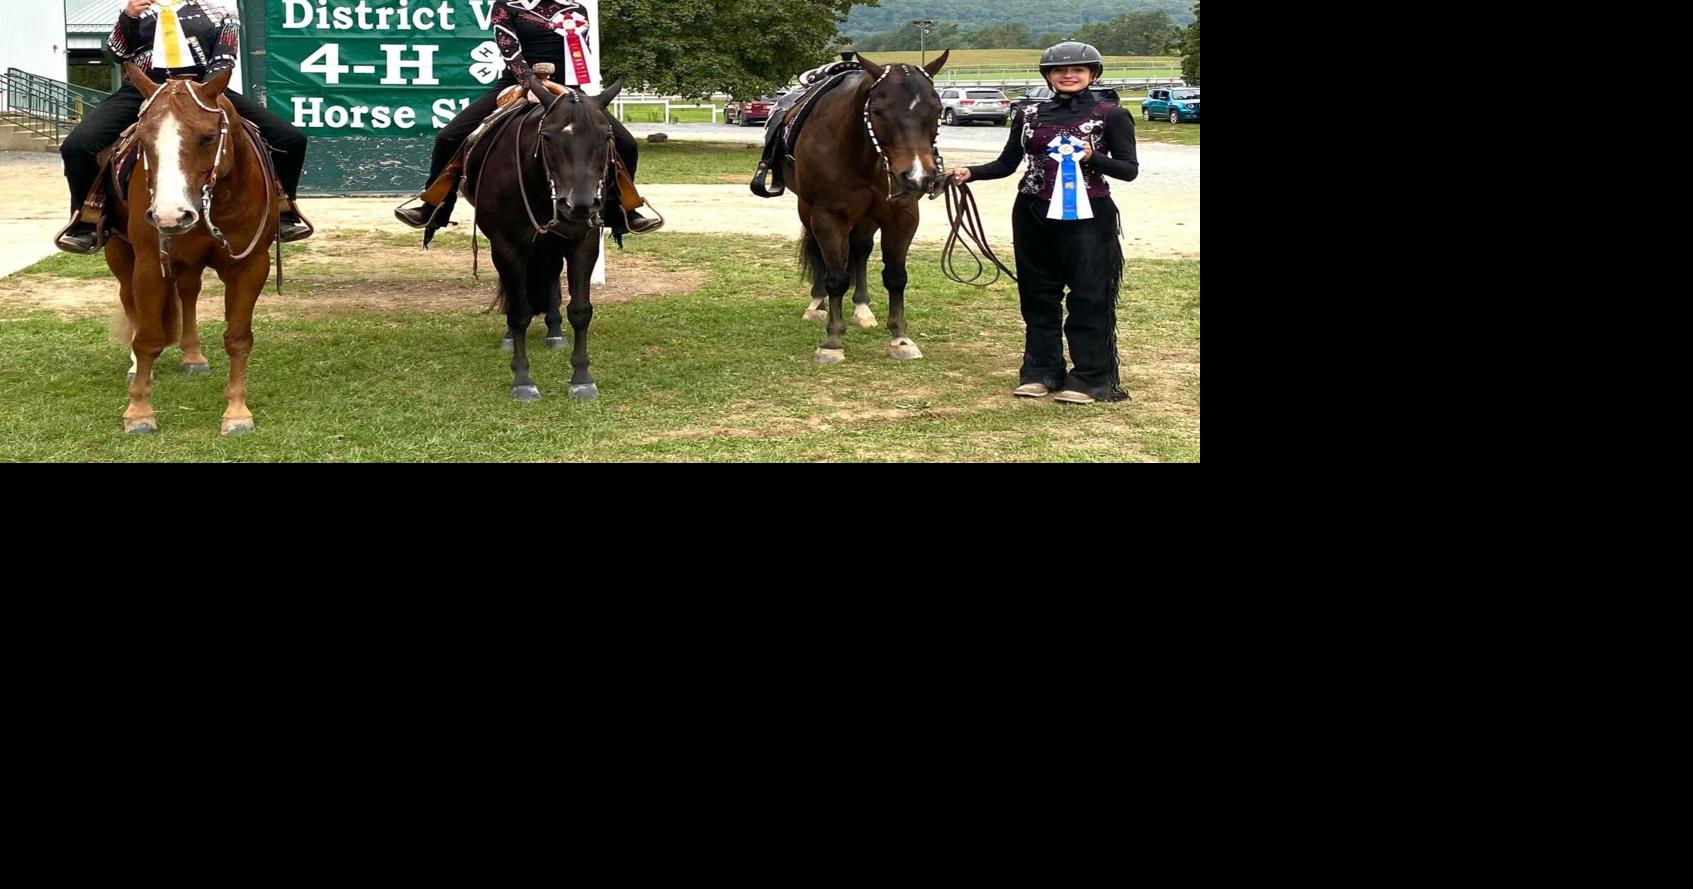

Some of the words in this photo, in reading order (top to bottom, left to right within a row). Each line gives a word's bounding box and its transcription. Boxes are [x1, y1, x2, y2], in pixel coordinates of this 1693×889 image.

[282, 0, 455, 30] District
[299, 43, 440, 85] 4-H
[290, 97, 416, 129] Horse
